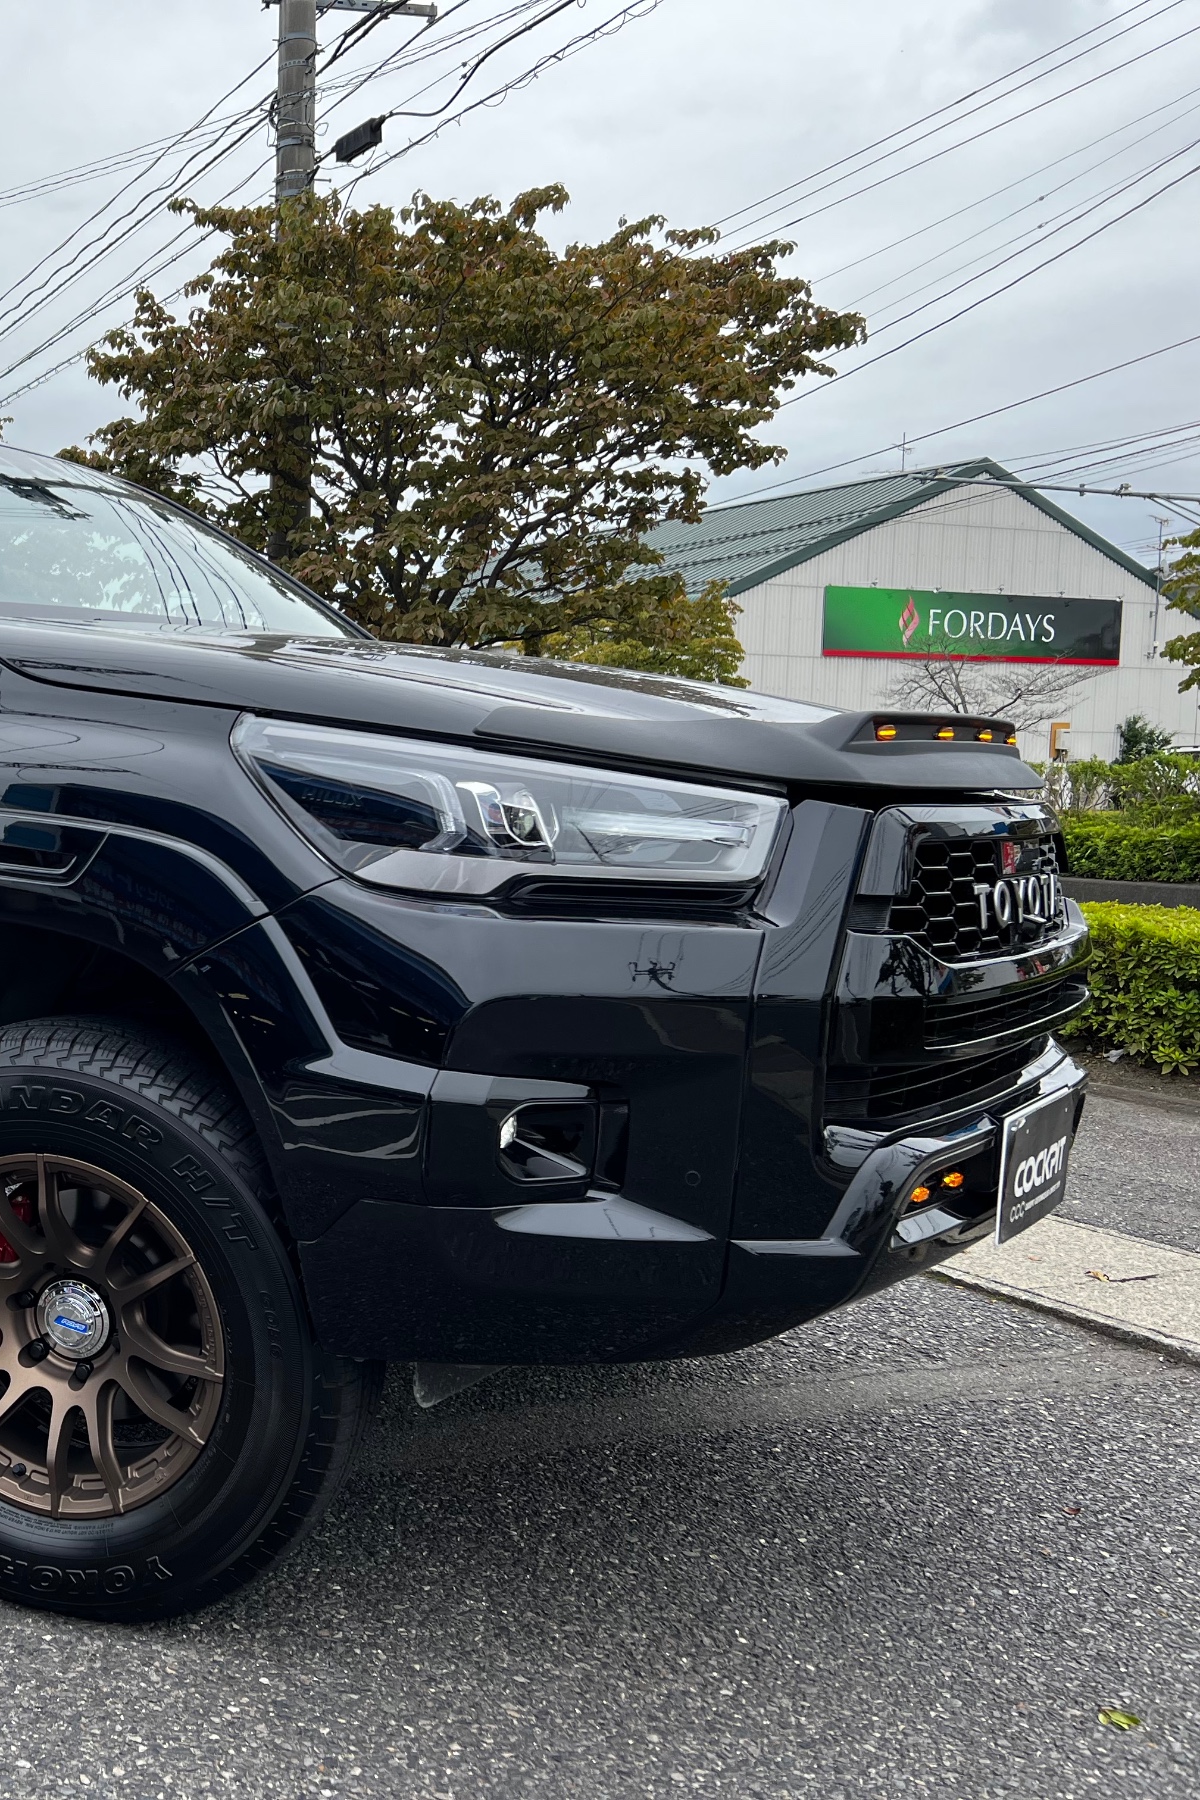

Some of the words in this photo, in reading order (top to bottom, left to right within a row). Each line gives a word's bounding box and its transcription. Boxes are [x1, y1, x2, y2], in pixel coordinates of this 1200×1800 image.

[928, 608, 1056, 643] FORDAYS
[1013, 1135, 1067, 1198] COCKPIT
[169, 1153, 259, 1251] H/T
